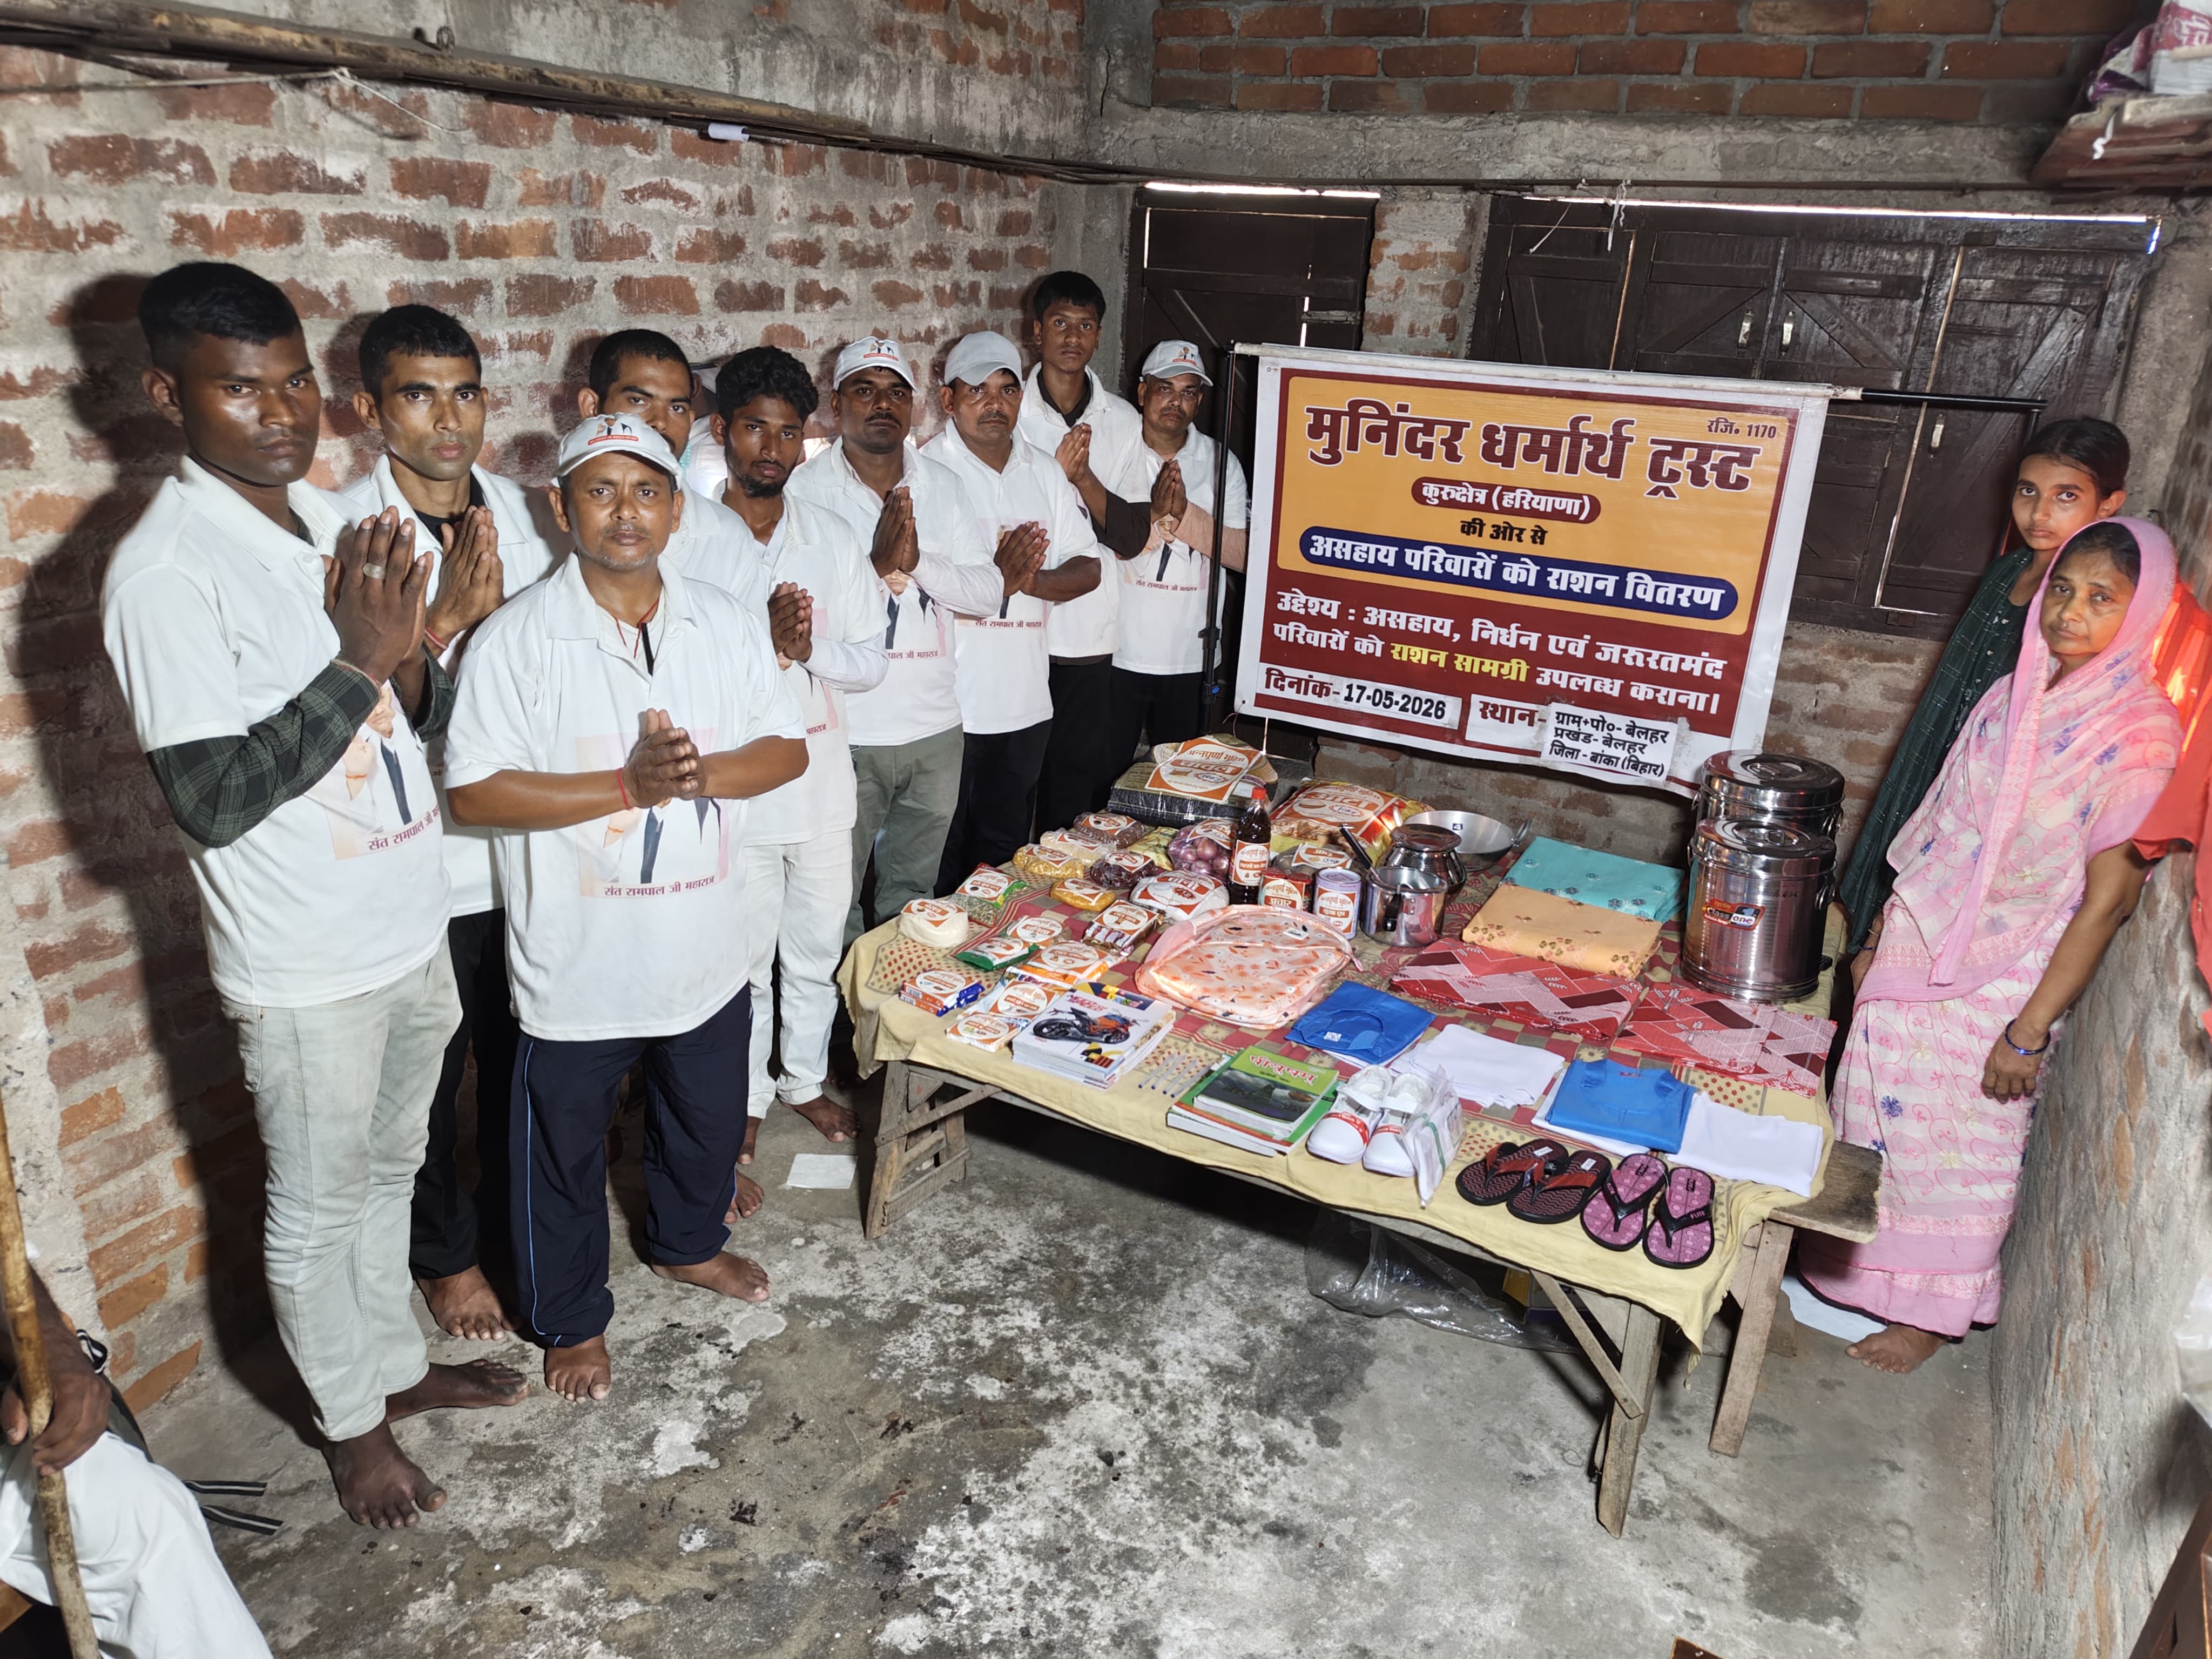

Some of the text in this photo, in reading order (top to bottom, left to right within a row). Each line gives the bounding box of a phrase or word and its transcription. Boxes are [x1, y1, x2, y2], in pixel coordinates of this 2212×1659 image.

[1746, 423, 1777, 439] 1170
[1305, 398, 1763, 500] मुनिंदर धर्मार्थ ट्रस्ट
[1422, 482, 1590, 520] कुरुक्षेत्र (हरियाणा)
[1460, 517, 1548, 545] की ओर से
[1310, 534, 1725, 611] असहाय परिवारों को राशन वितरण
[1016, 620, 1024, 628] जी
[1276, 588, 1728, 679] उद्देश्य : असहाय, निर्धन एवं जरूरतमंद
[906, 650, 914, 659] जी
[917, 650, 938, 658] महाराज
[1273, 622, 1720, 714] परिवारों को राशन सामग्री उपलब्ध कराना।
[1265, 667, 1446, 720] दिनांक- 17-05-2026
[1479, 700, 1546, 727] स्थान-
[1625, 720, 1669, 744] बेलहर
[1554, 726, 1648, 754] प्रखंड- बेलहर
[1180, 761, 1237, 774] चावल
[1549, 741, 1581, 760] जिला
[1590, 750, 1621, 770] बांका
[1621, 757, 1664, 776] (बिहार)
[367, 811, 433, 850] संत रामपाल जी
[605, 875, 715, 896] संत रामपाल जी महाराज
[1707, 907, 1730, 920] Class
[1733, 916, 1753, 924] one
